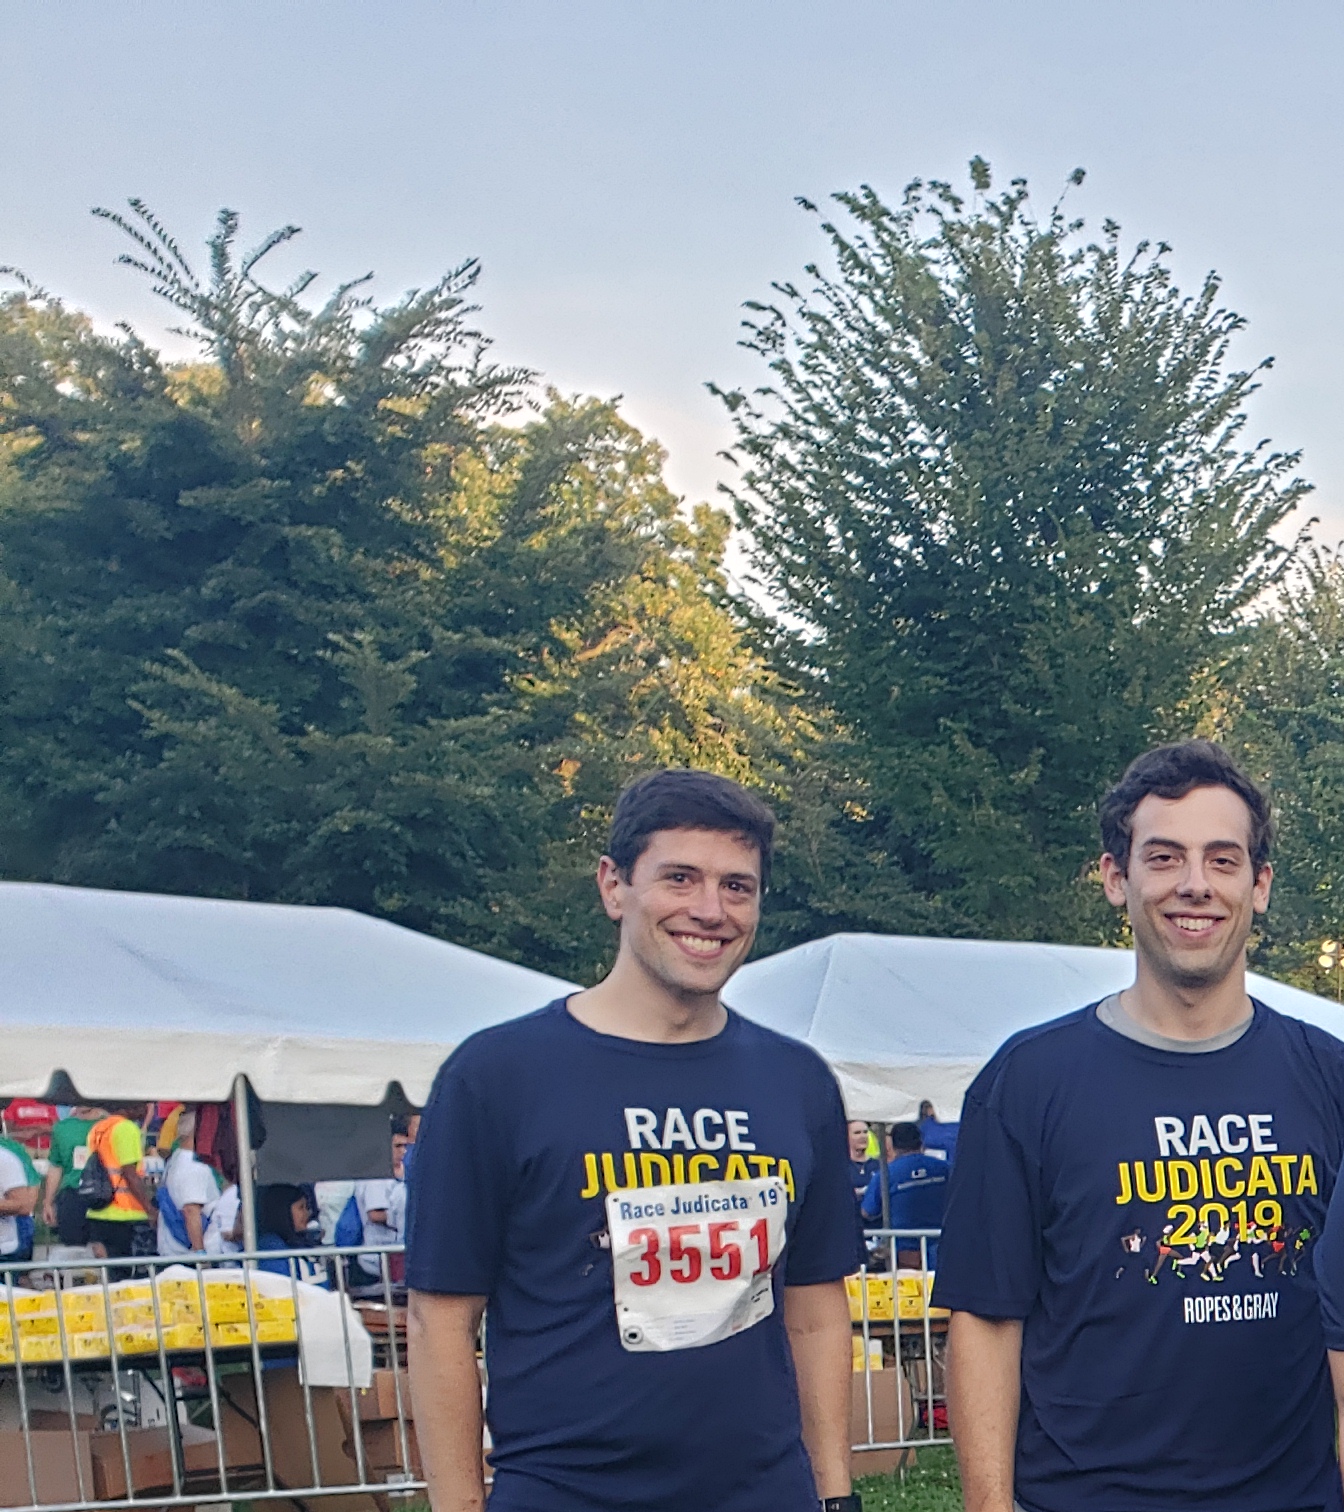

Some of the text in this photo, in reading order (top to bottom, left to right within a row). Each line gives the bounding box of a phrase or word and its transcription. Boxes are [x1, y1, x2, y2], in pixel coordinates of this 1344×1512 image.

[624, 1107, 756, 1151] RACE
[1154, 1113, 1278, 1157] RACE
[581, 1152, 795, 1203] JUDICATA
[1115, 1154, 1318, 1205] JUDICATA
[620, 1200, 665, 1221] Race
[1166, 1199, 1283, 1247] 2019
[628, 1217, 770, 1287] 3551
